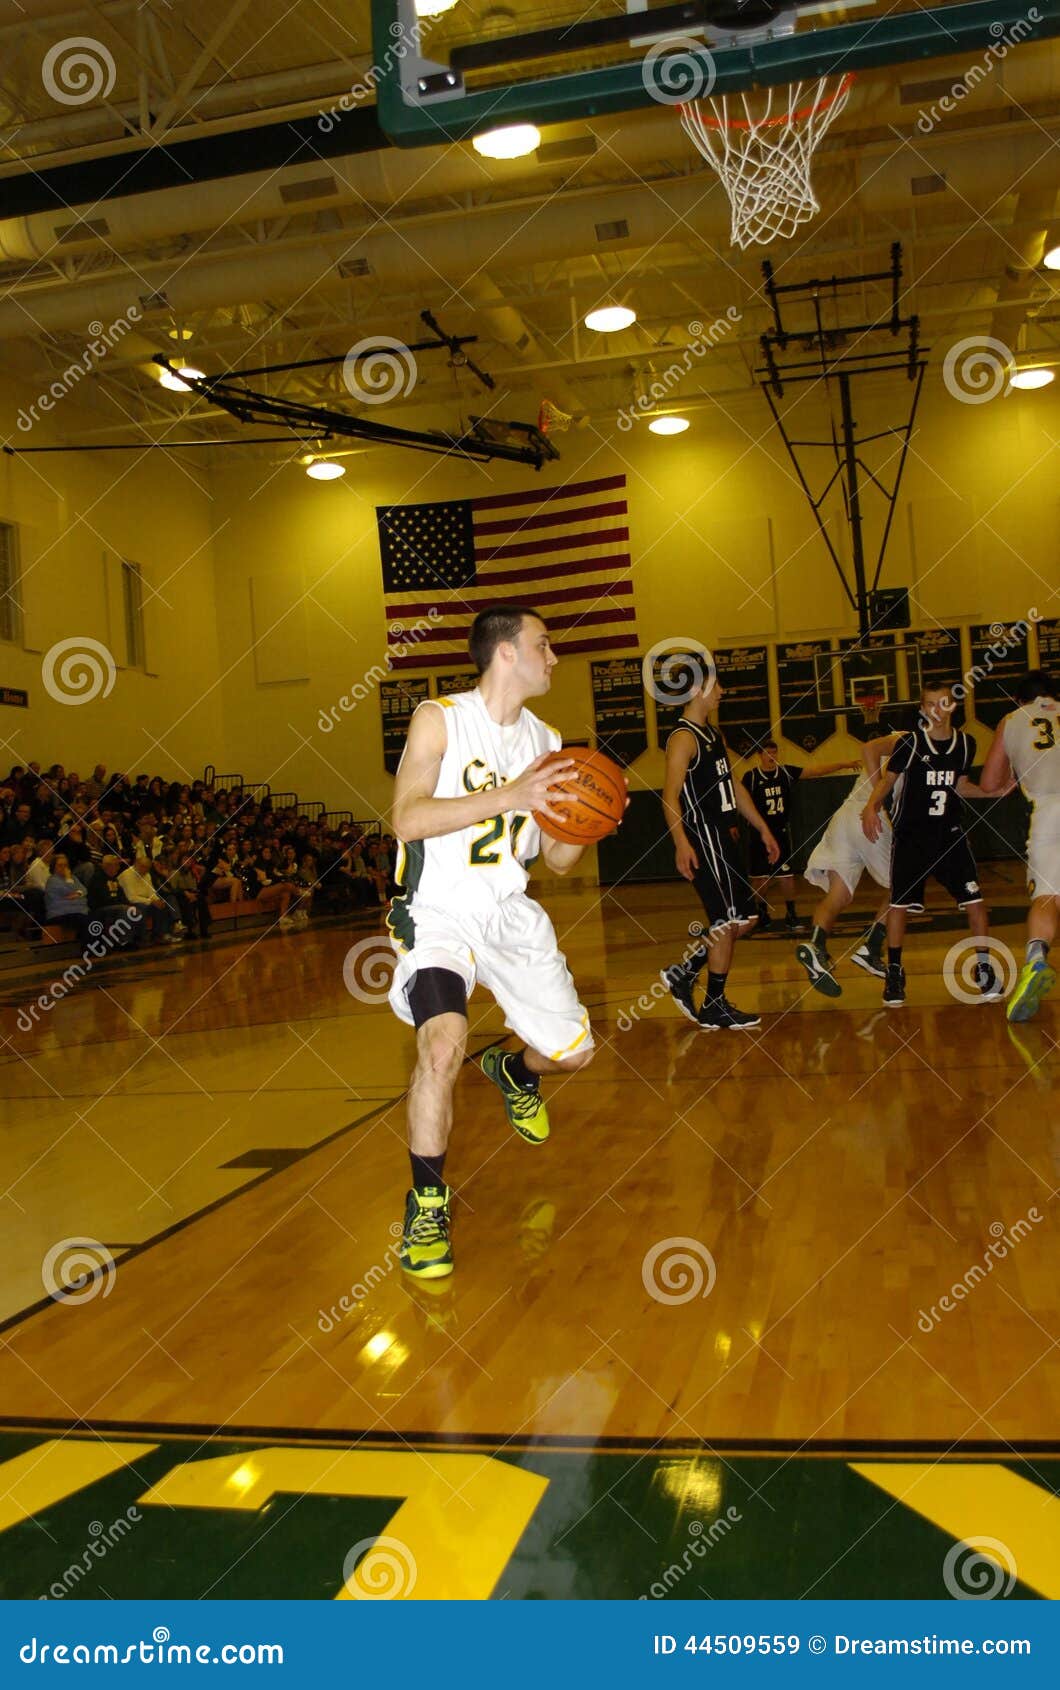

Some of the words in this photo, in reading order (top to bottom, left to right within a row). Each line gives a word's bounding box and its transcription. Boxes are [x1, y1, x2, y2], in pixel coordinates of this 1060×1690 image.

[1032, 714, 1060, 750] 3
[926, 770, 954, 786] RFH
[765, 786, 781, 797] RFH
[766, 797, 784, 815] 24
[928, 790, 947, 816] 3
